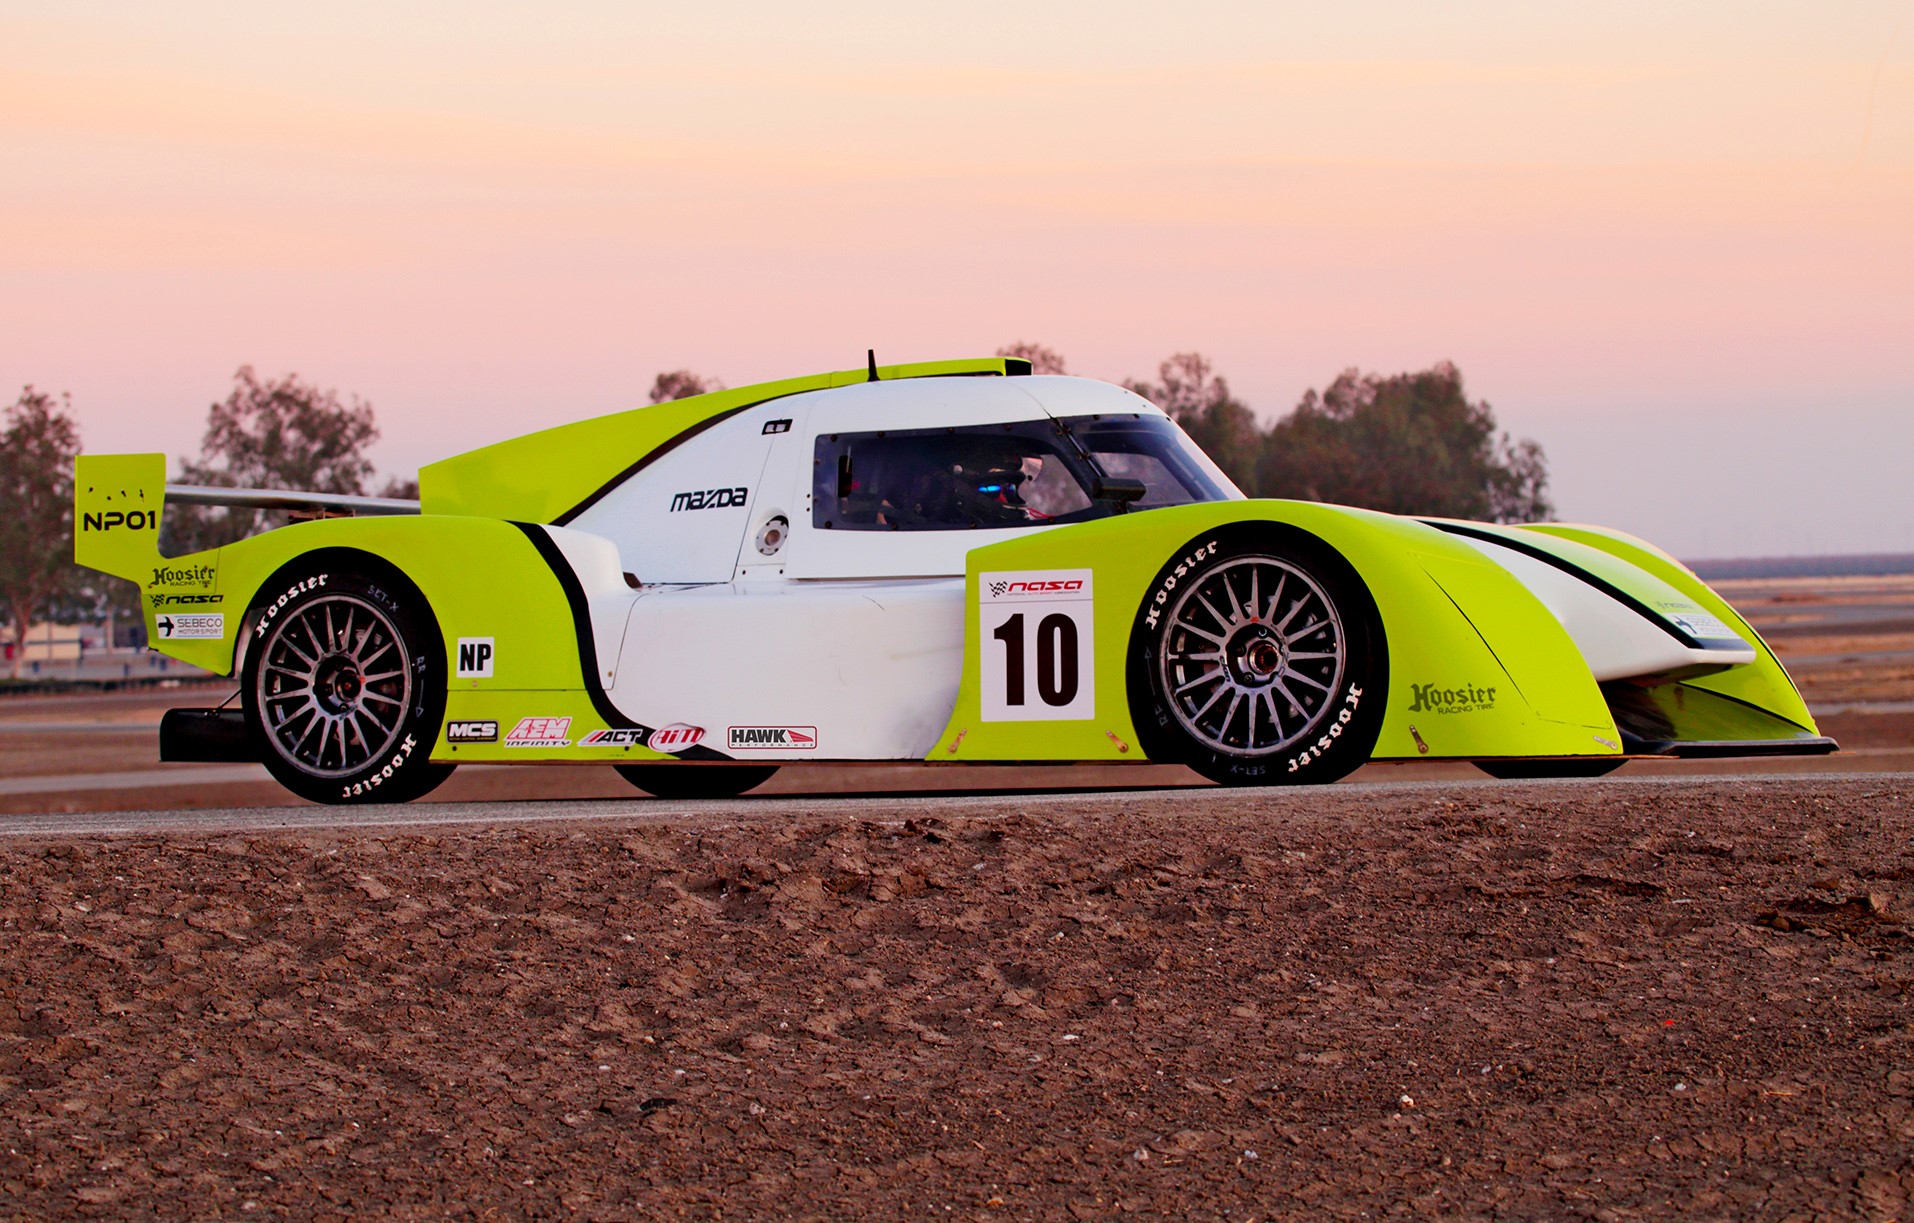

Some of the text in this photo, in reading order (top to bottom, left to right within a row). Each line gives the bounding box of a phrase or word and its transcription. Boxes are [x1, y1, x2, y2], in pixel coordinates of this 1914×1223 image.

[84, 510, 156, 531] NP01
[150, 565, 215, 585] Hoosier
[1145, 541, 1217, 630] Hoosier
[255, 574, 328, 638] Hoosier
[177, 618, 223, 627] SEBECO
[460, 643, 492, 671] NP
[994, 613, 1078, 707] 10
[1408, 683, 1496, 713] Hoosier
[1438, 702, 1494, 715] RACING TIRE
[449, 723, 497, 737] MCS
[506, 718, 572, 740] AEM
[731, 729, 786, 743] HAWK
[1288, 682, 1363, 772] Hoosier
[342, 733, 417, 798] Hoosier
